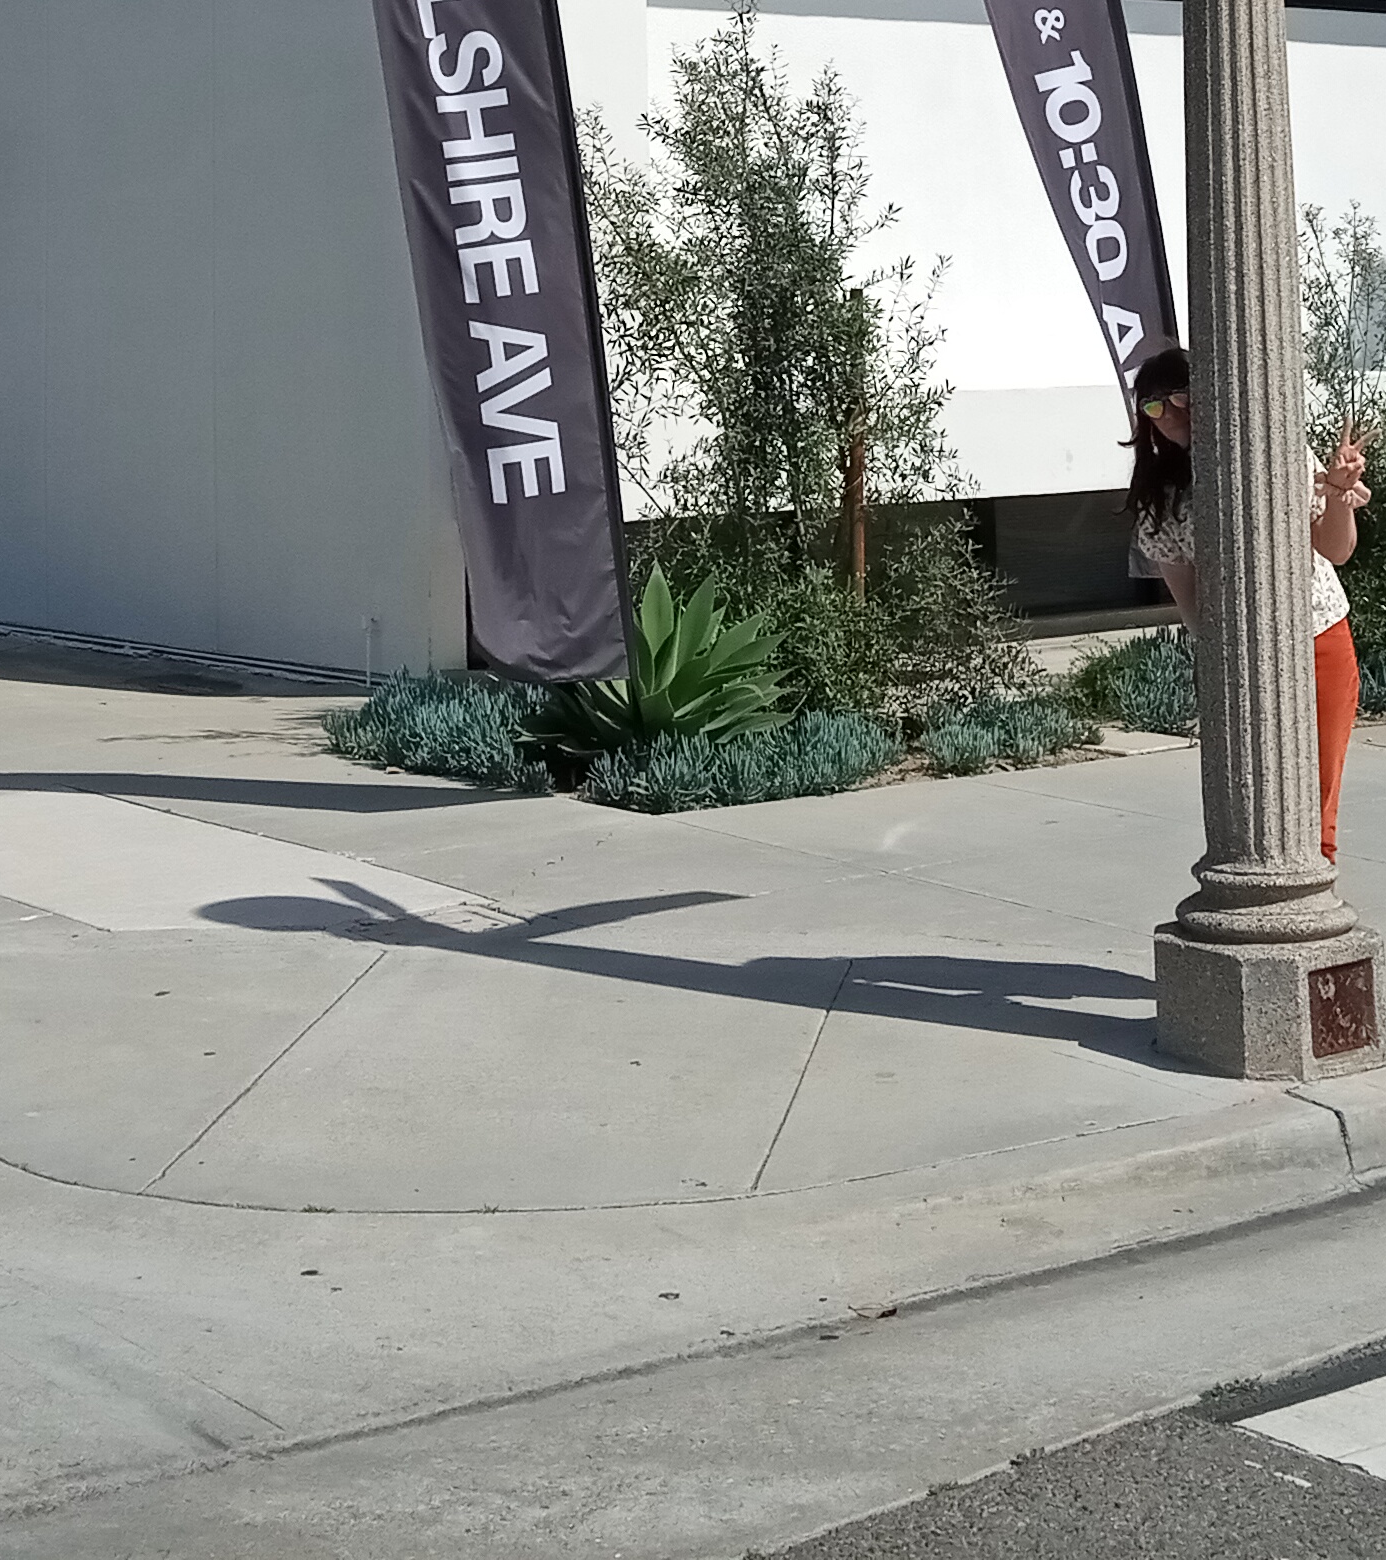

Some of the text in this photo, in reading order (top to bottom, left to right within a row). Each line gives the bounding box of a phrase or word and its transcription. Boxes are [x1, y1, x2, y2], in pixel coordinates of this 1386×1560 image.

[1033, 7, 1067, 45] &
[1033, 47, 1129, 285] 10:30
[470, 319, 567, 507] AVE
[1101, 302, 1145, 392] A
